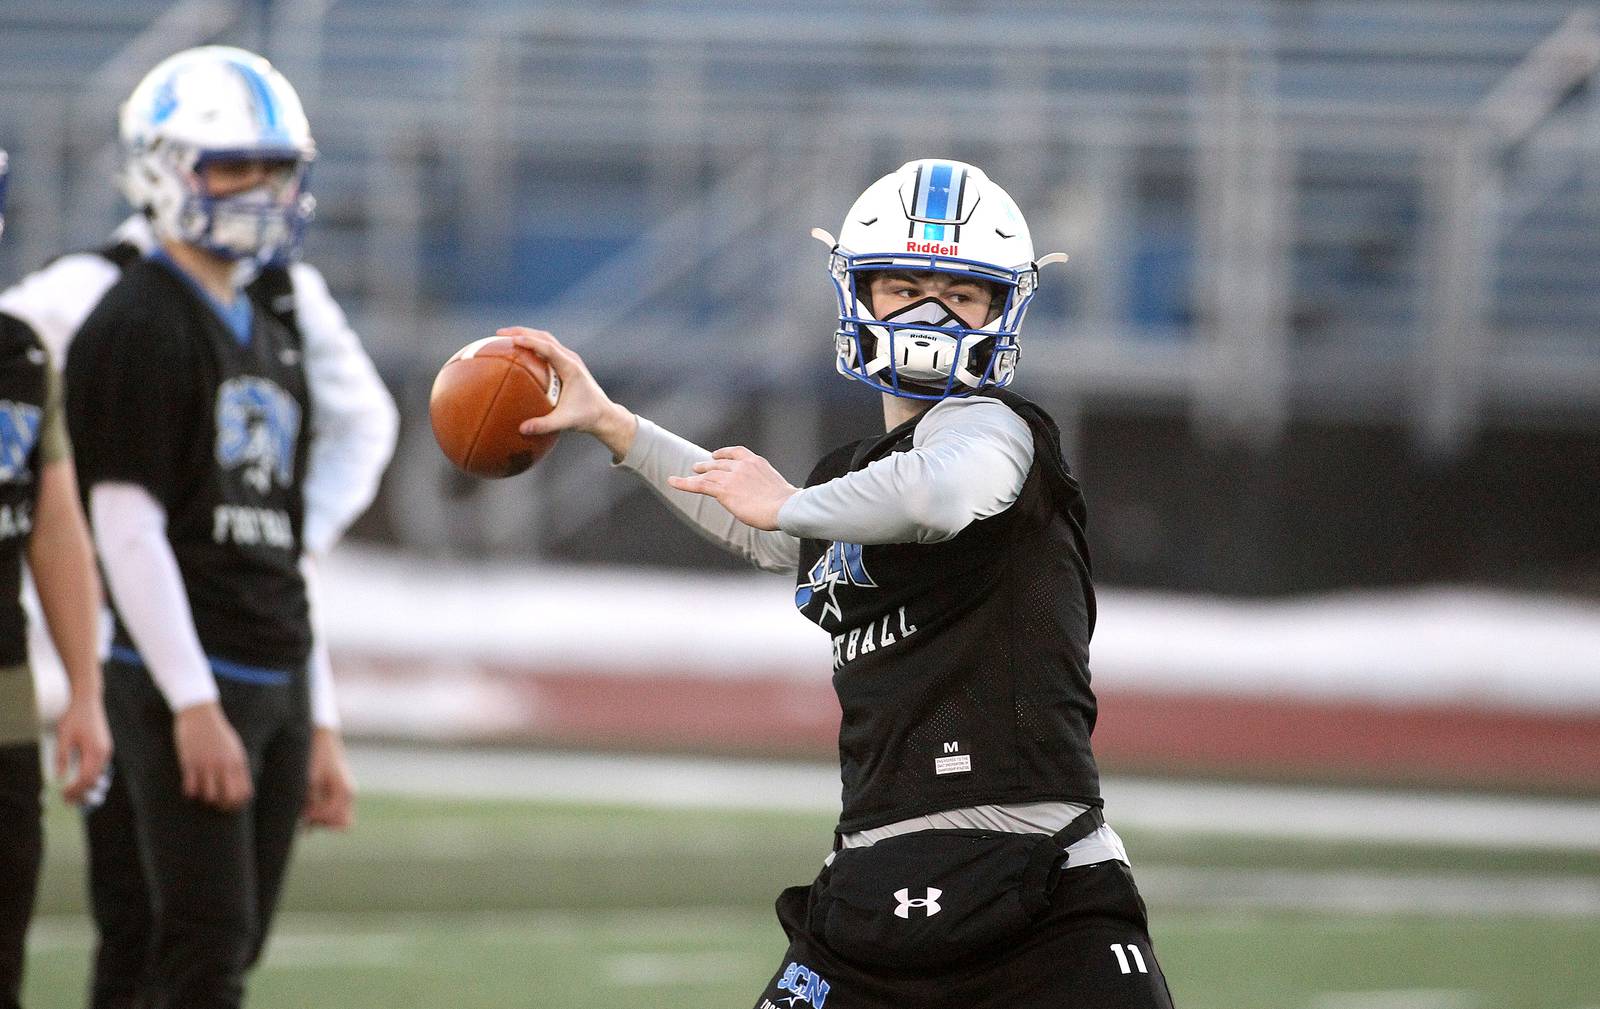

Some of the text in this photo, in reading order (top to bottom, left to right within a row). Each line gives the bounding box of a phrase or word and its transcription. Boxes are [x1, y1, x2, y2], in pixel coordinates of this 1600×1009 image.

[906, 241, 958, 256] Riddell
[832, 606, 918, 671] TBALL
[943, 741, 959, 753] M
[1110, 943, 1149, 974] 11
[777, 962, 831, 1009] SCN
